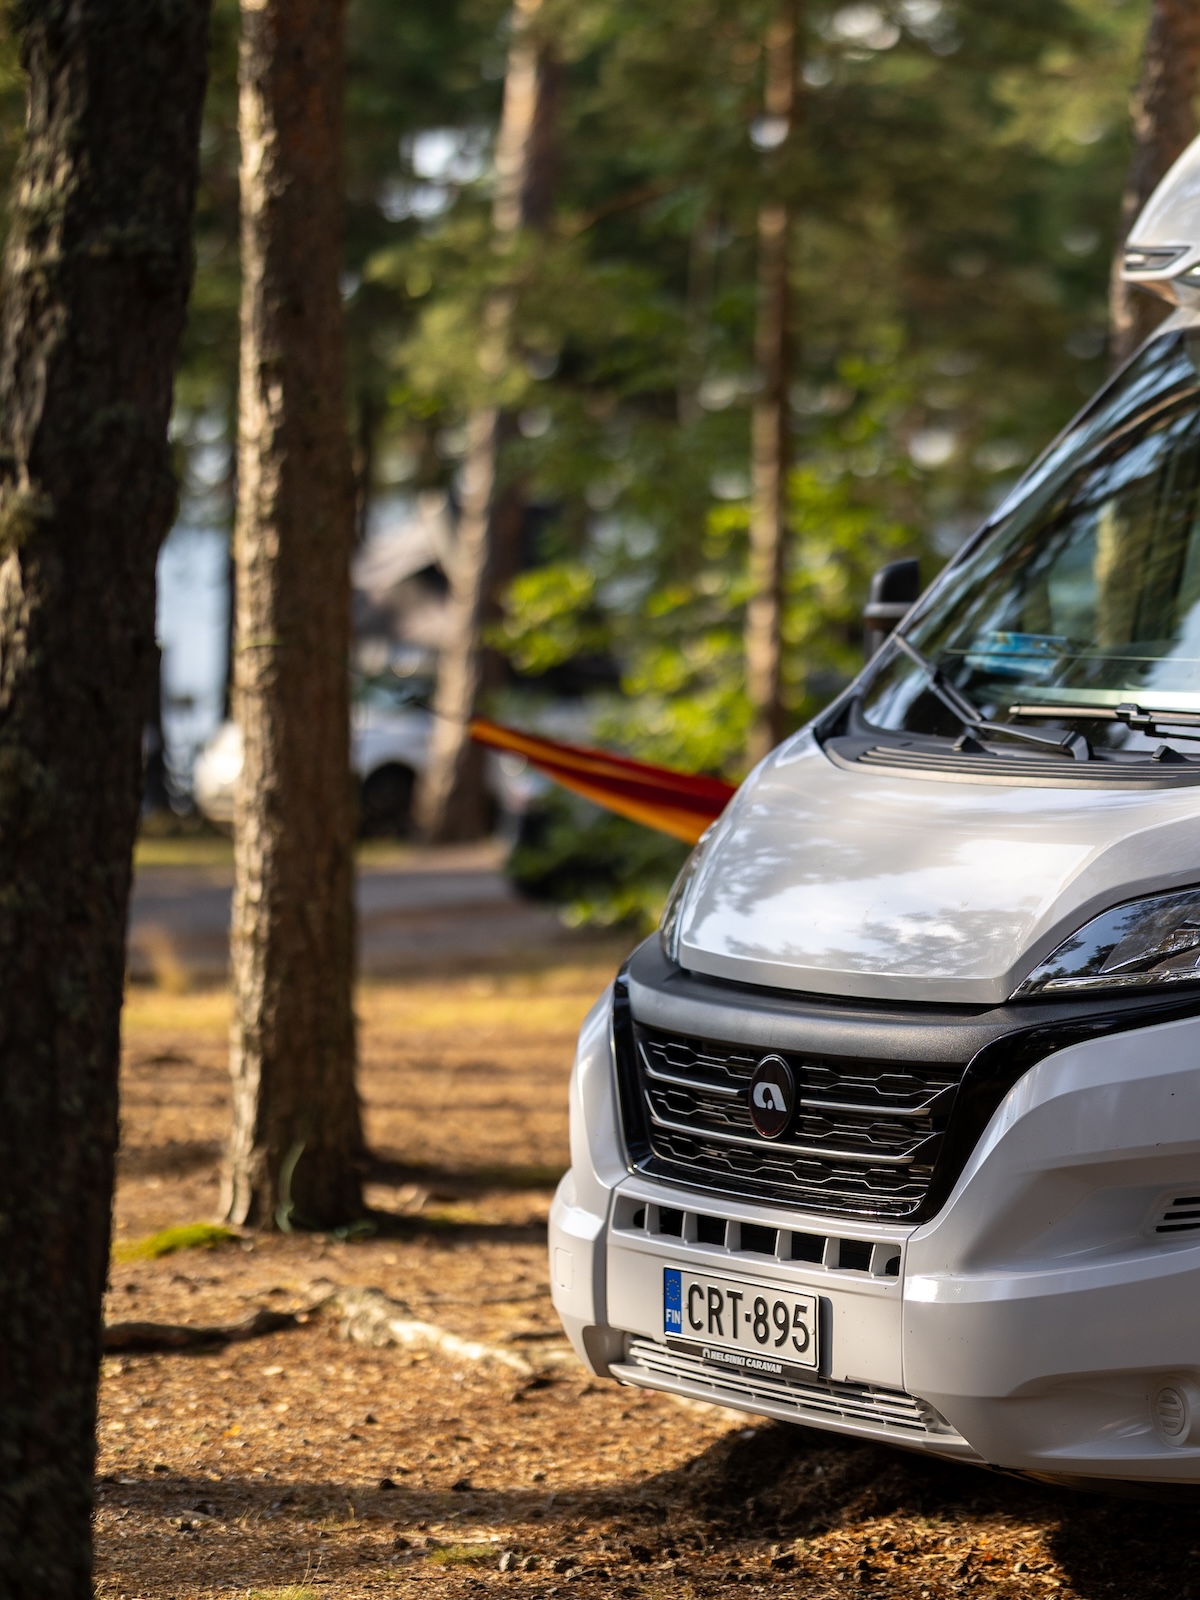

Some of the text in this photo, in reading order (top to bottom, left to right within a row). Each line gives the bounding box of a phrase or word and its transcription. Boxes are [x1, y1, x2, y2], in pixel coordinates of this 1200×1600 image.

[665, 1308, 681, 1325] FIN
[687, 1281, 810, 1353] CRT-895
[710, 1350, 783, 1374] HELSINKI CARAVAN
